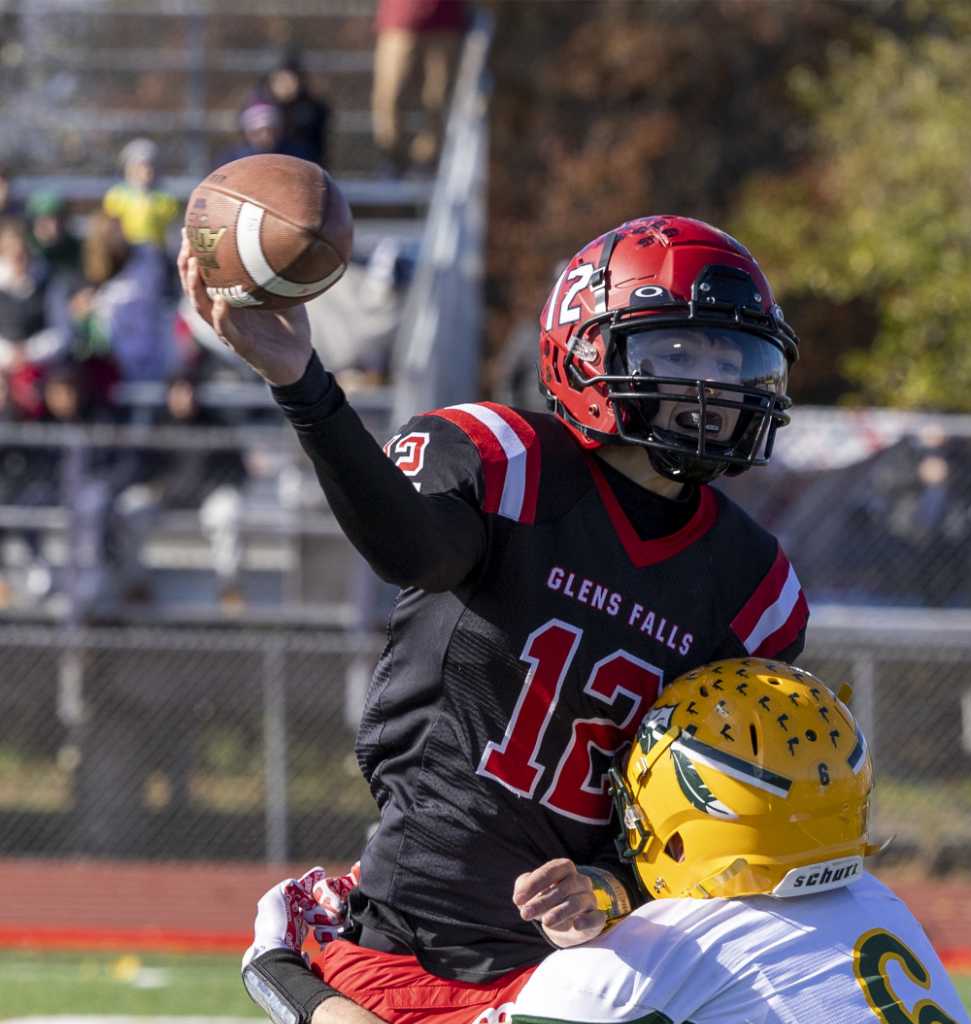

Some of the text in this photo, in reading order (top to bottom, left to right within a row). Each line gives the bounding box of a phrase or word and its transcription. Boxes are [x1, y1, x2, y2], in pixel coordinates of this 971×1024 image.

[545, 263, 594, 331] 12
[383, 432, 430, 493] 2
[547, 566, 694, 656] GLENS FALLS
[476, 618, 665, 826] 12
[817, 763, 830, 786] 6
